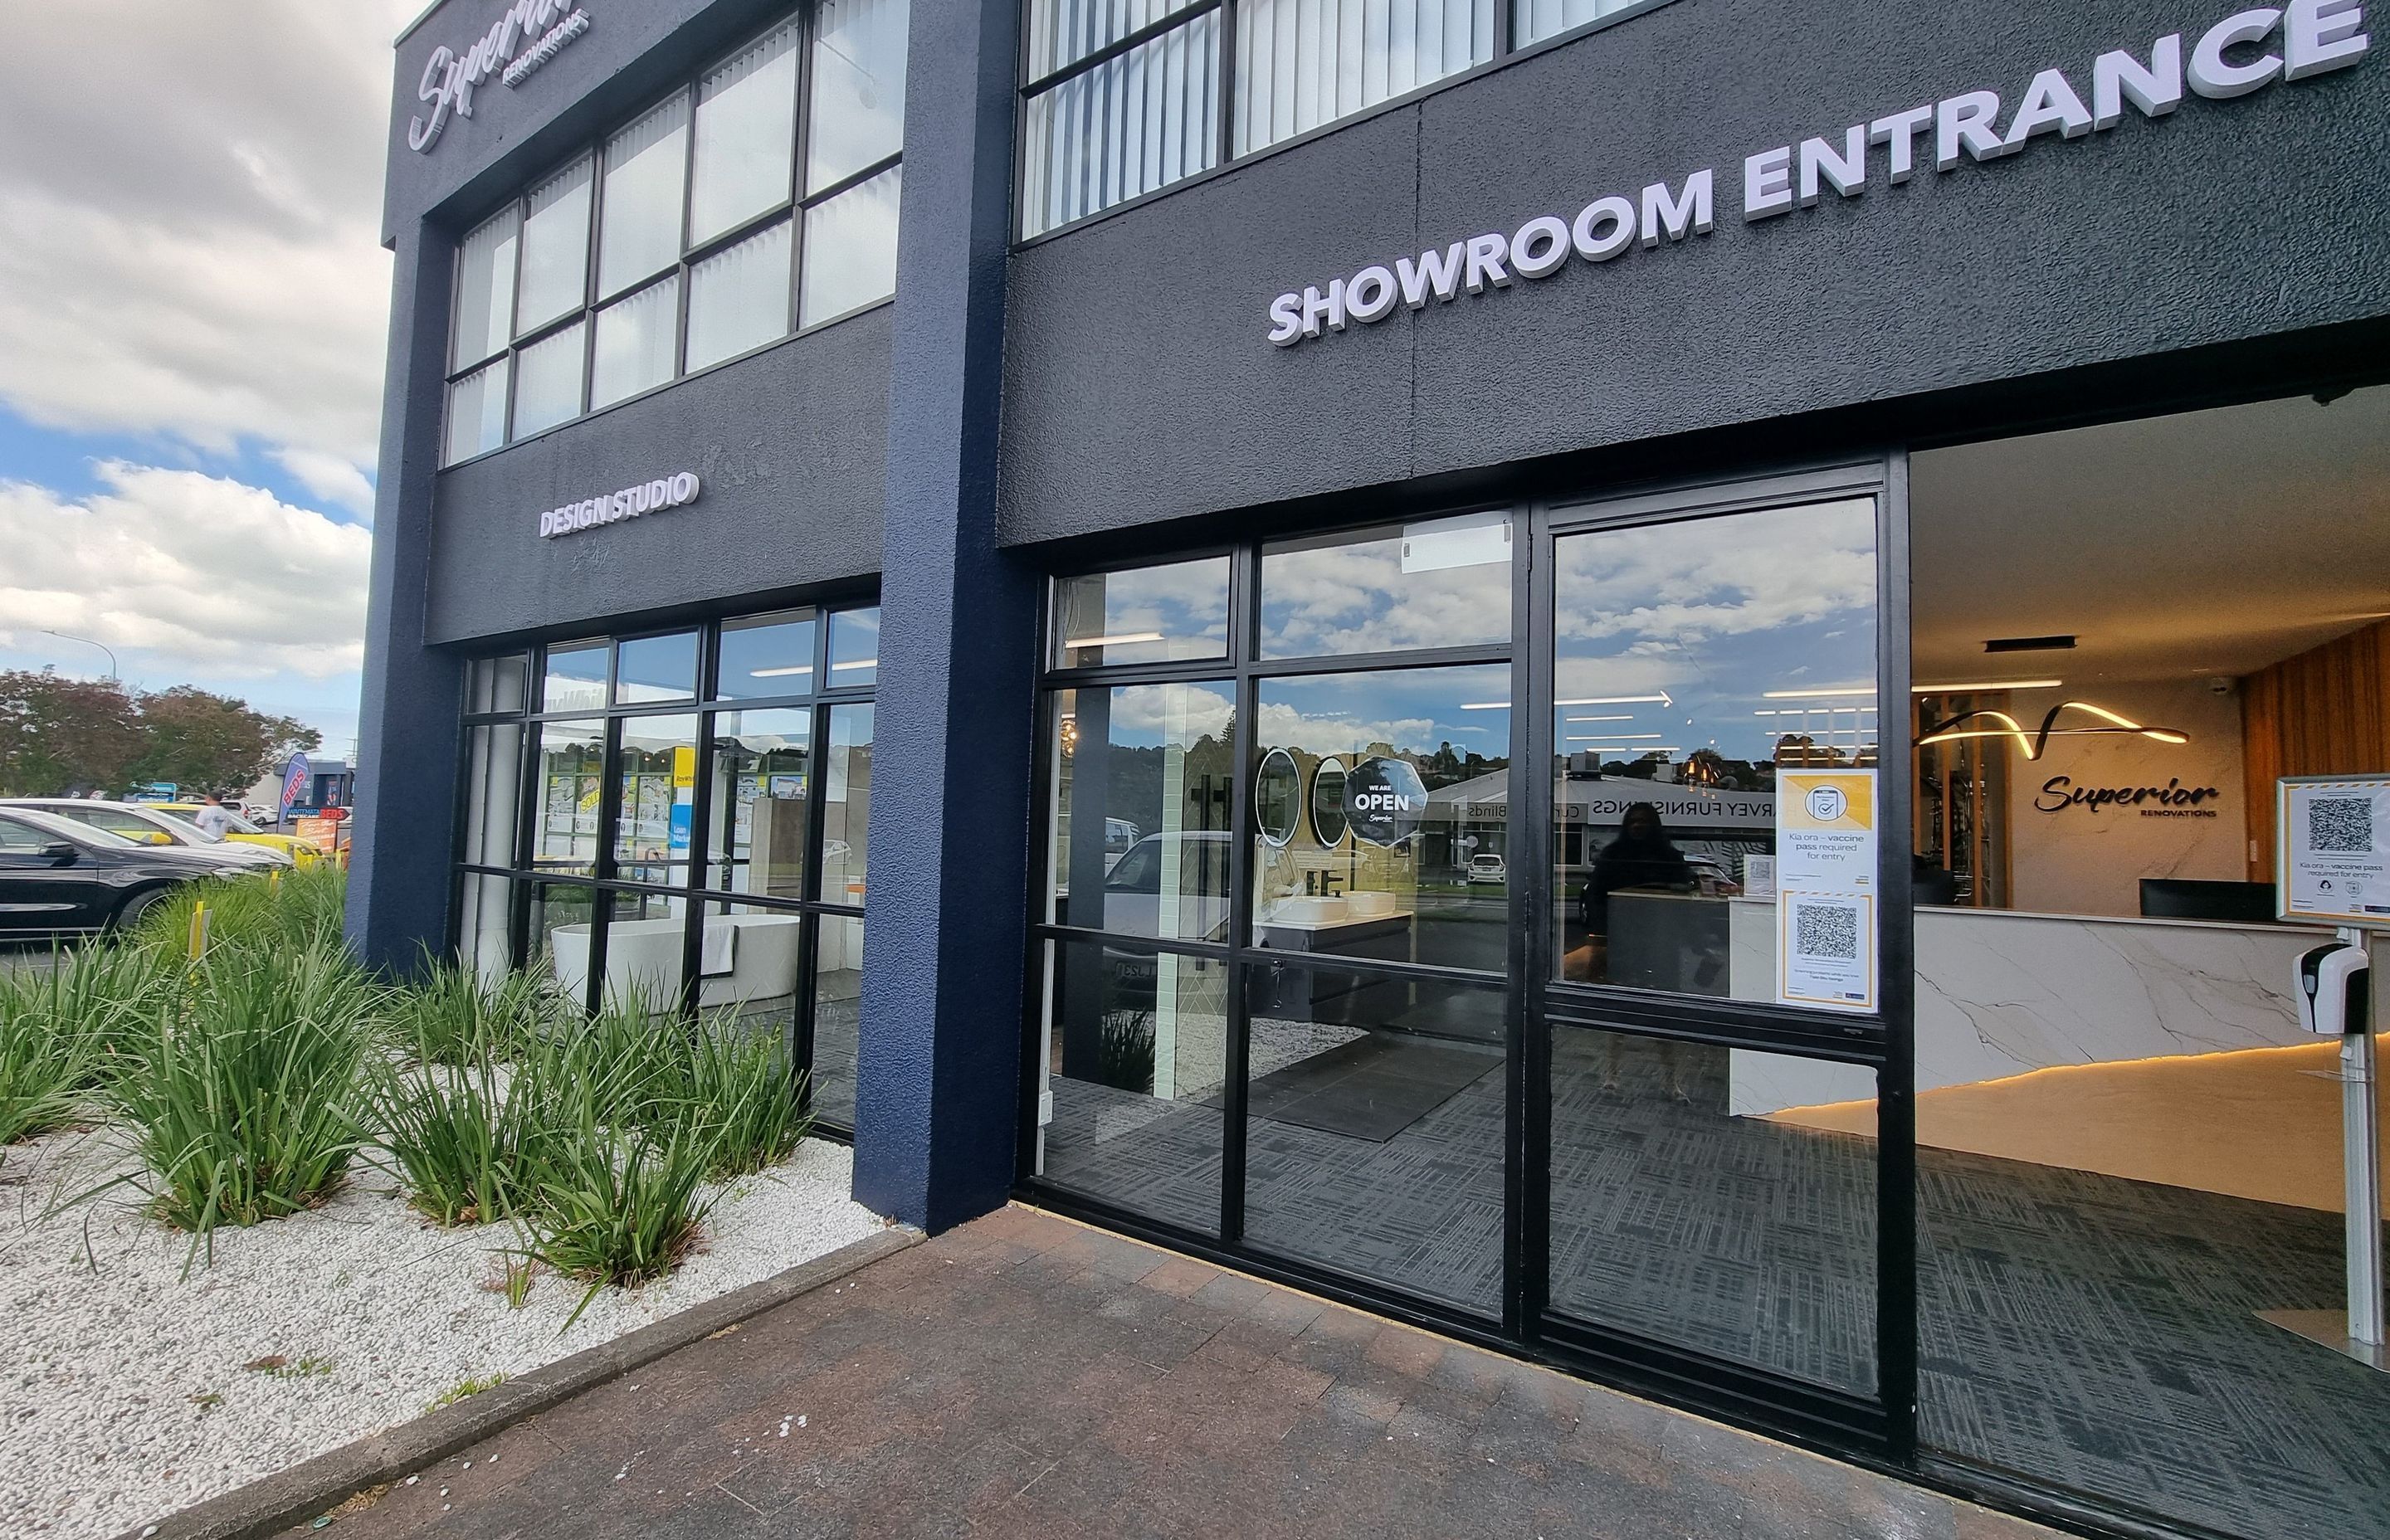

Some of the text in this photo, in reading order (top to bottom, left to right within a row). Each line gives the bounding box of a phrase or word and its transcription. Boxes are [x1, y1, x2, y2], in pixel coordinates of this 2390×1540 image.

[502, 8, 590, 90] RENOVATIONS
[1267, 0, 2368, 347] SHOWROOM ENTRANCE
[539, 471, 700, 539] DESIGN STUDIO
[283, 770, 305, 807] BEDS
[1354, 793, 1409, 811] OPEN
[2034, 776, 2219, 813] Superior
[320, 808, 344, 818] BEDS
[1827, 834, 1864, 842] vaccine
[1822, 853, 1846, 861] entry
